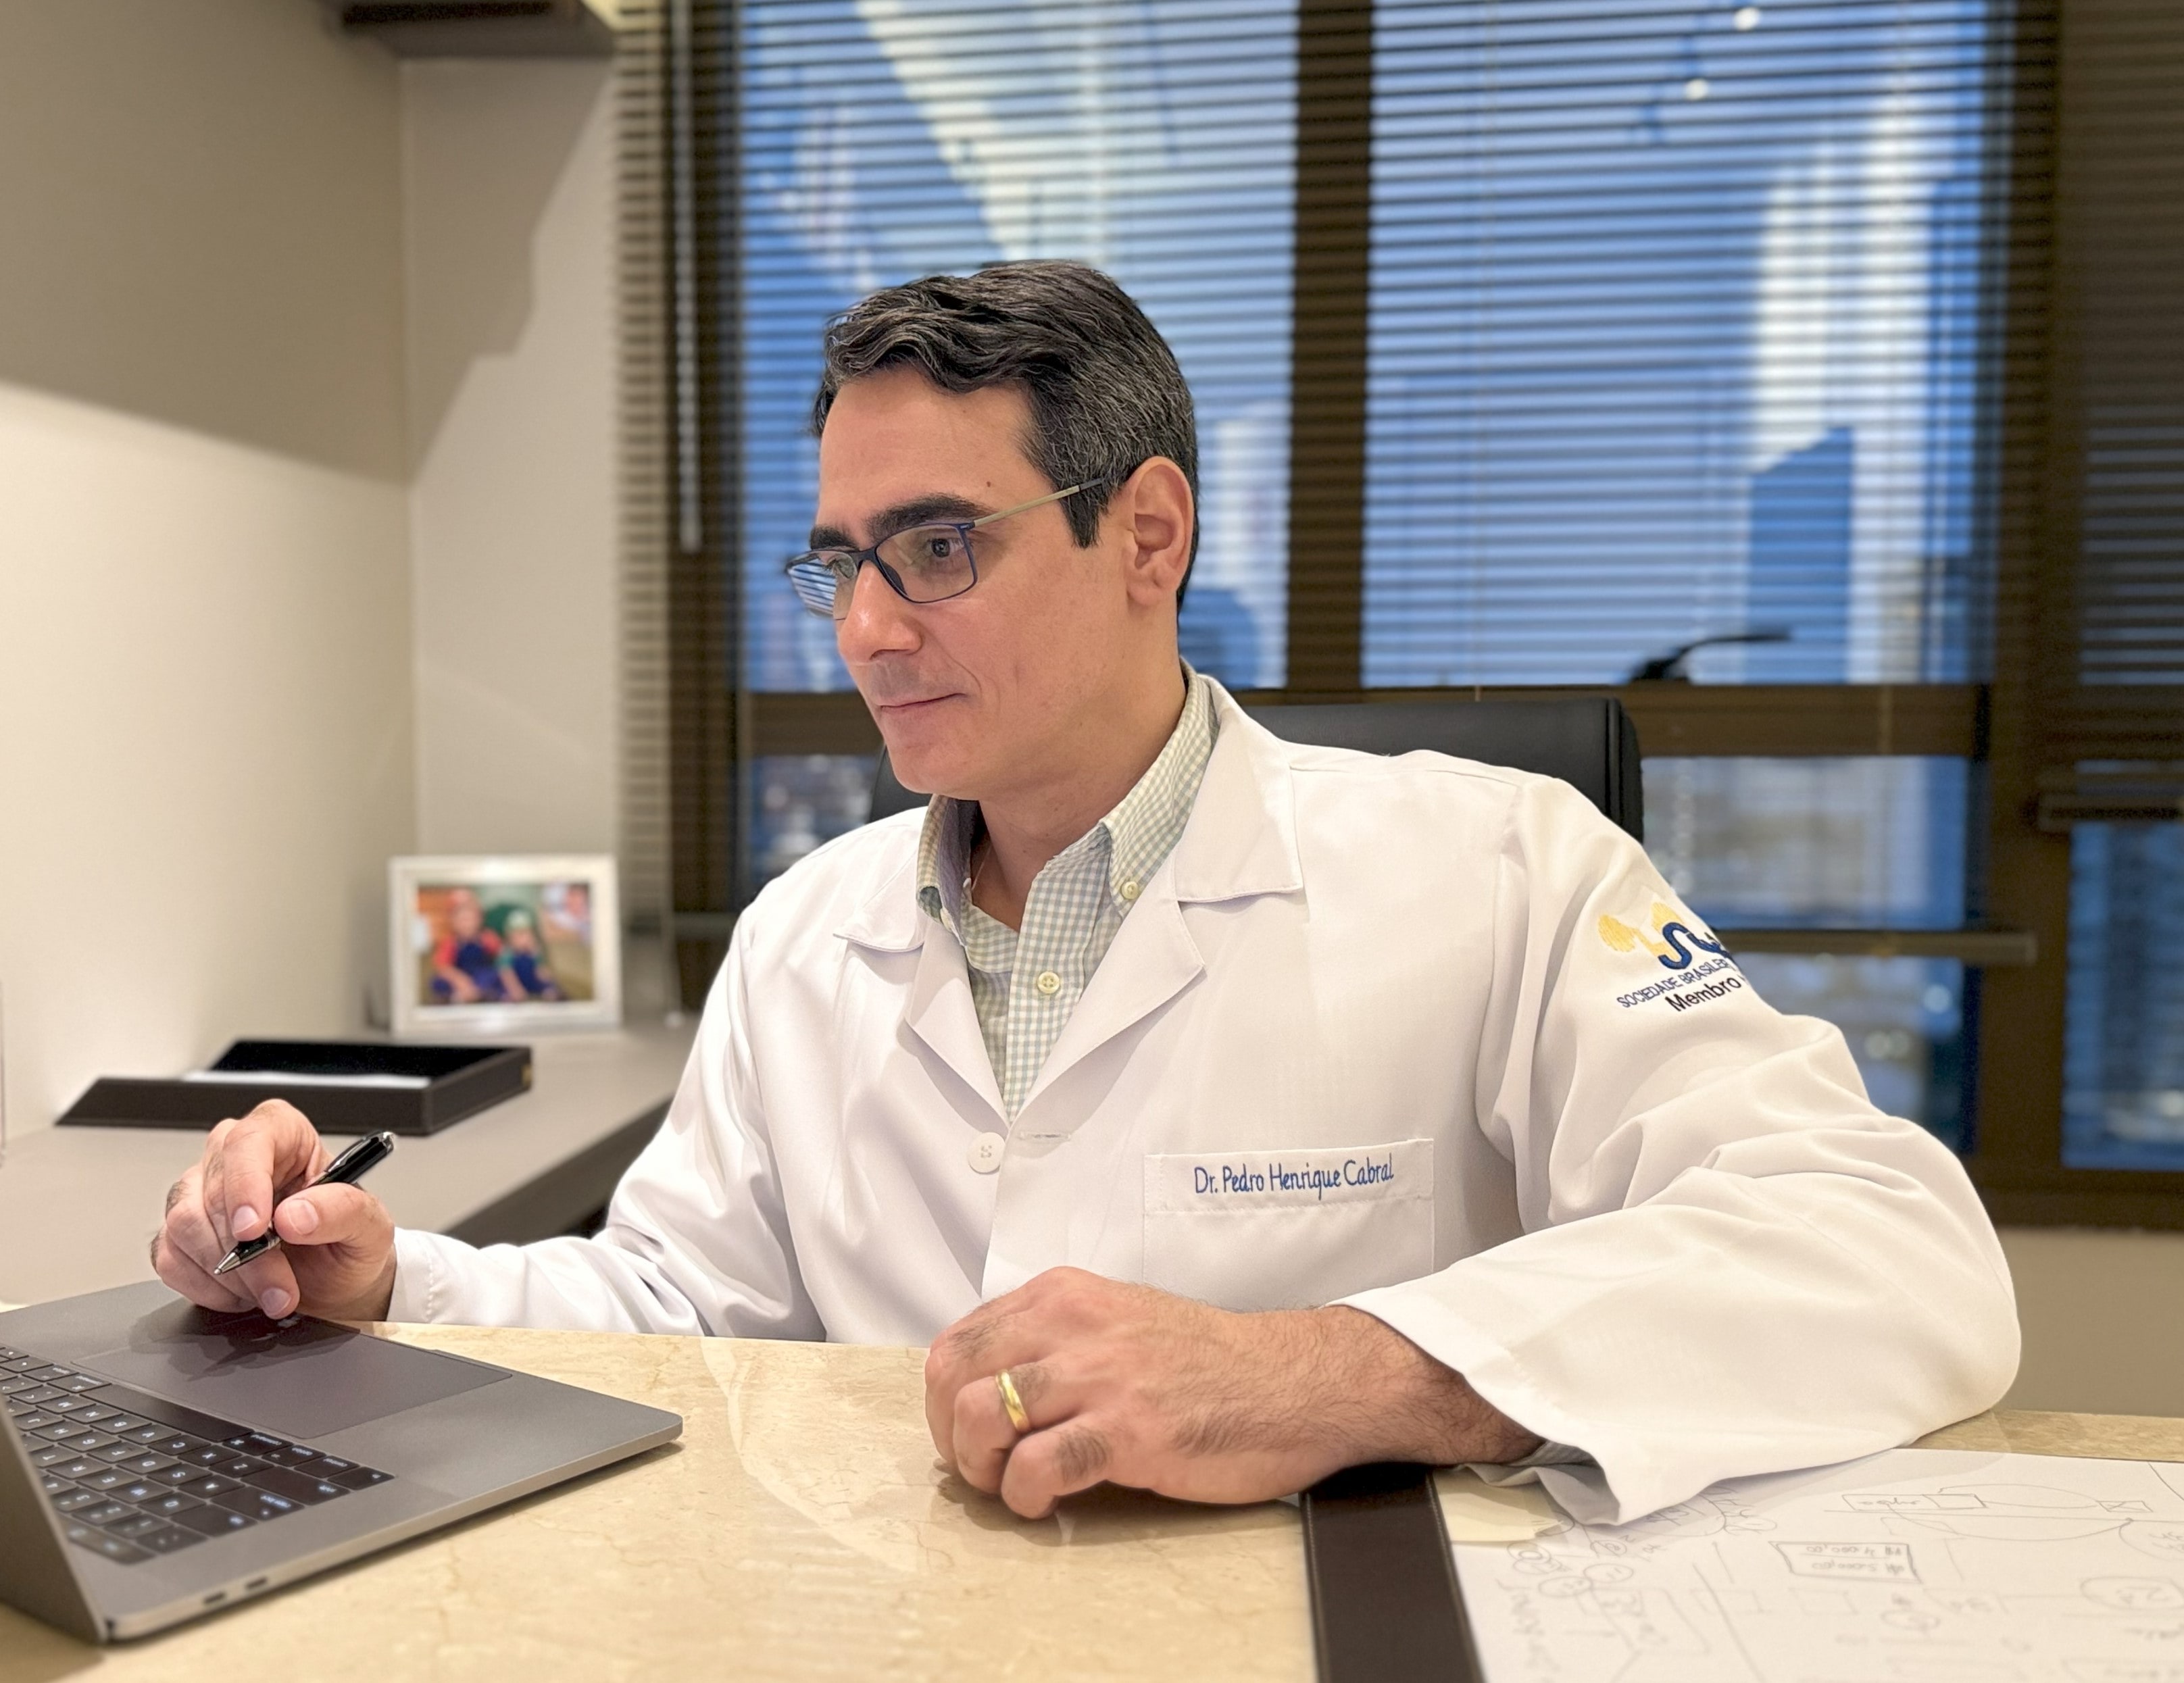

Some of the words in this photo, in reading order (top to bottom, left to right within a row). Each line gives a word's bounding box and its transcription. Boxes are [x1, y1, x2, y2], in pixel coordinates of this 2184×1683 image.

[1616, 977, 1683, 1007] SOCIEDADE
[1664, 977, 1742, 1011] Membro
[1194, 1166, 1218, 1194] Dr.
[1222, 1163, 1264, 1192] Pedro
[1269, 1162, 1341, 1201] Henrique
[1343, 1153, 1395, 1186] Cabral
